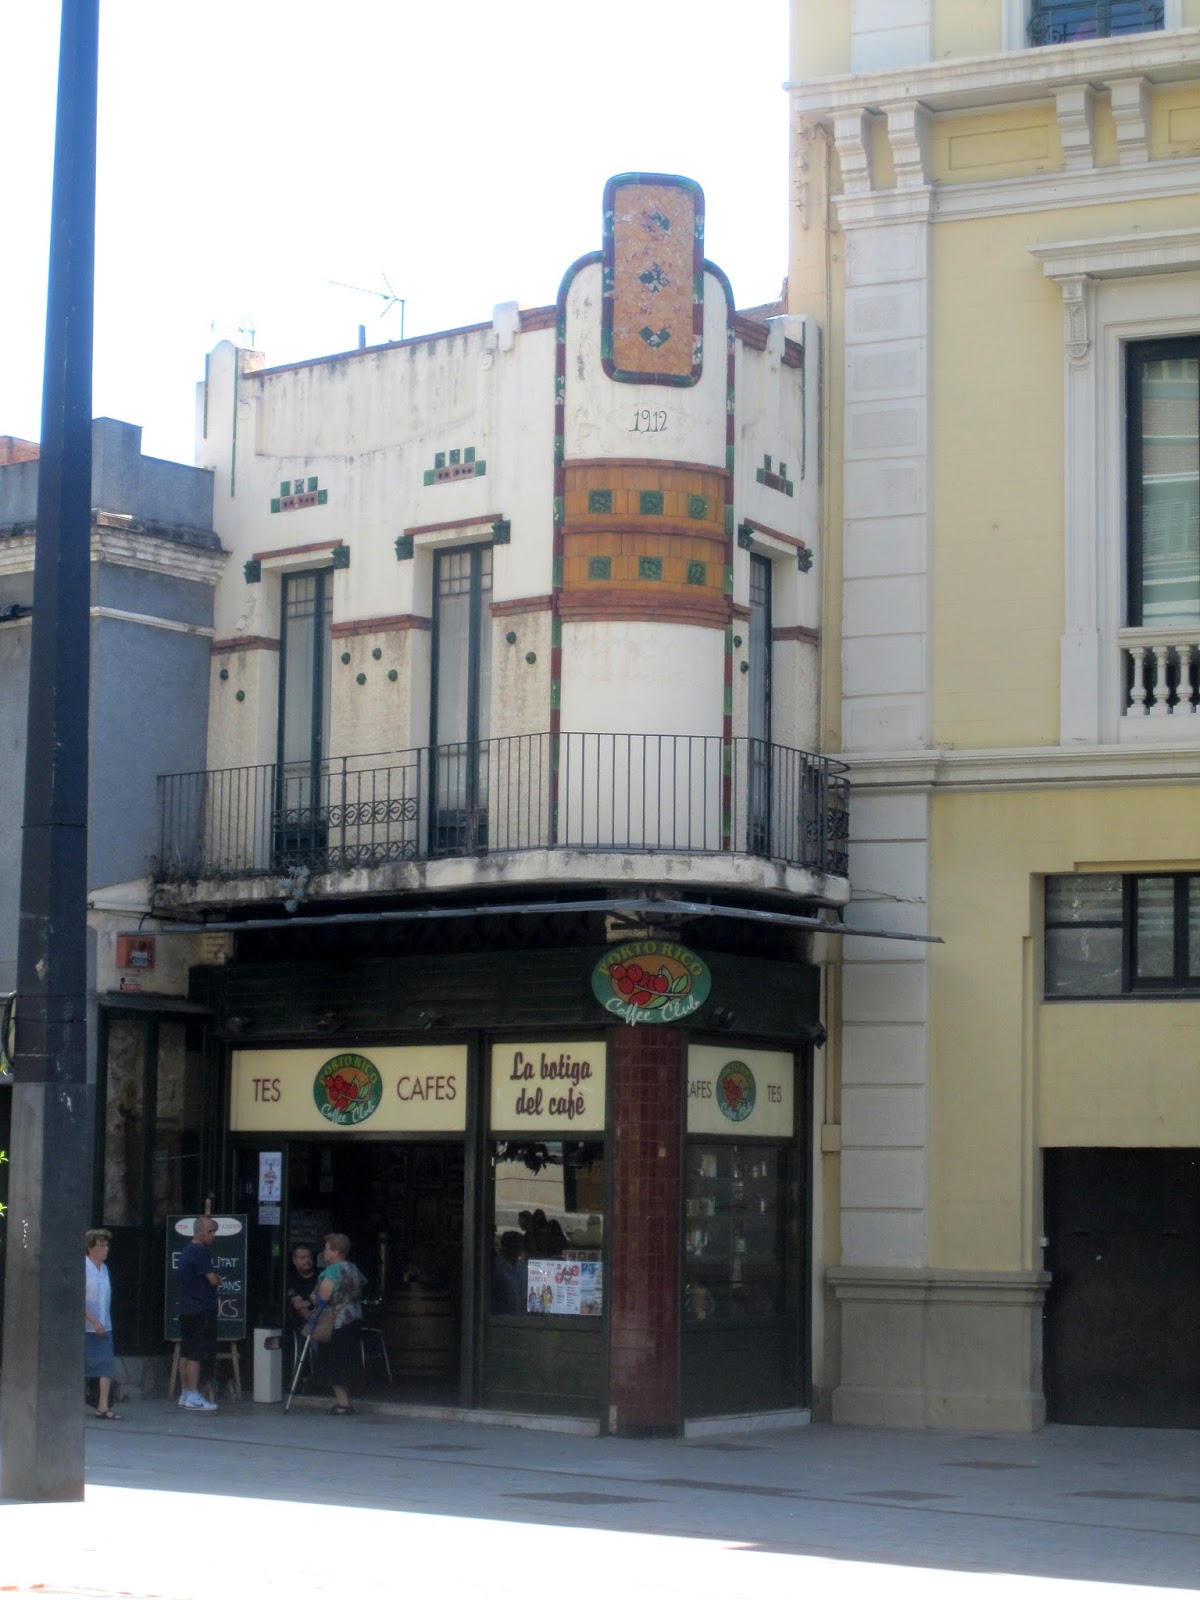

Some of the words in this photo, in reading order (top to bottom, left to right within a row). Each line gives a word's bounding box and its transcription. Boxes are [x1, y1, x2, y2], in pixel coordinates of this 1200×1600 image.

[628, 408, 667, 433] 1912
[662, 942, 703, 976] RICO
[605, 998, 652, 1027] Coffee
[659, 994, 701, 1021] Club
[354, 1055, 378, 1084] RICO
[509, 1051, 535, 1080] La
[541, 1052, 592, 1086] botiga
[253, 1078, 281, 1102] TES
[396, 1075, 457, 1101] CAFES
[767, 1085, 782, 1103] TES
[320, 1102, 347, 1124] Coffee
[351, 1103, 376, 1123] Club
[515, 1087, 543, 1115] del
[549, 1087, 586, 1120] cafè
